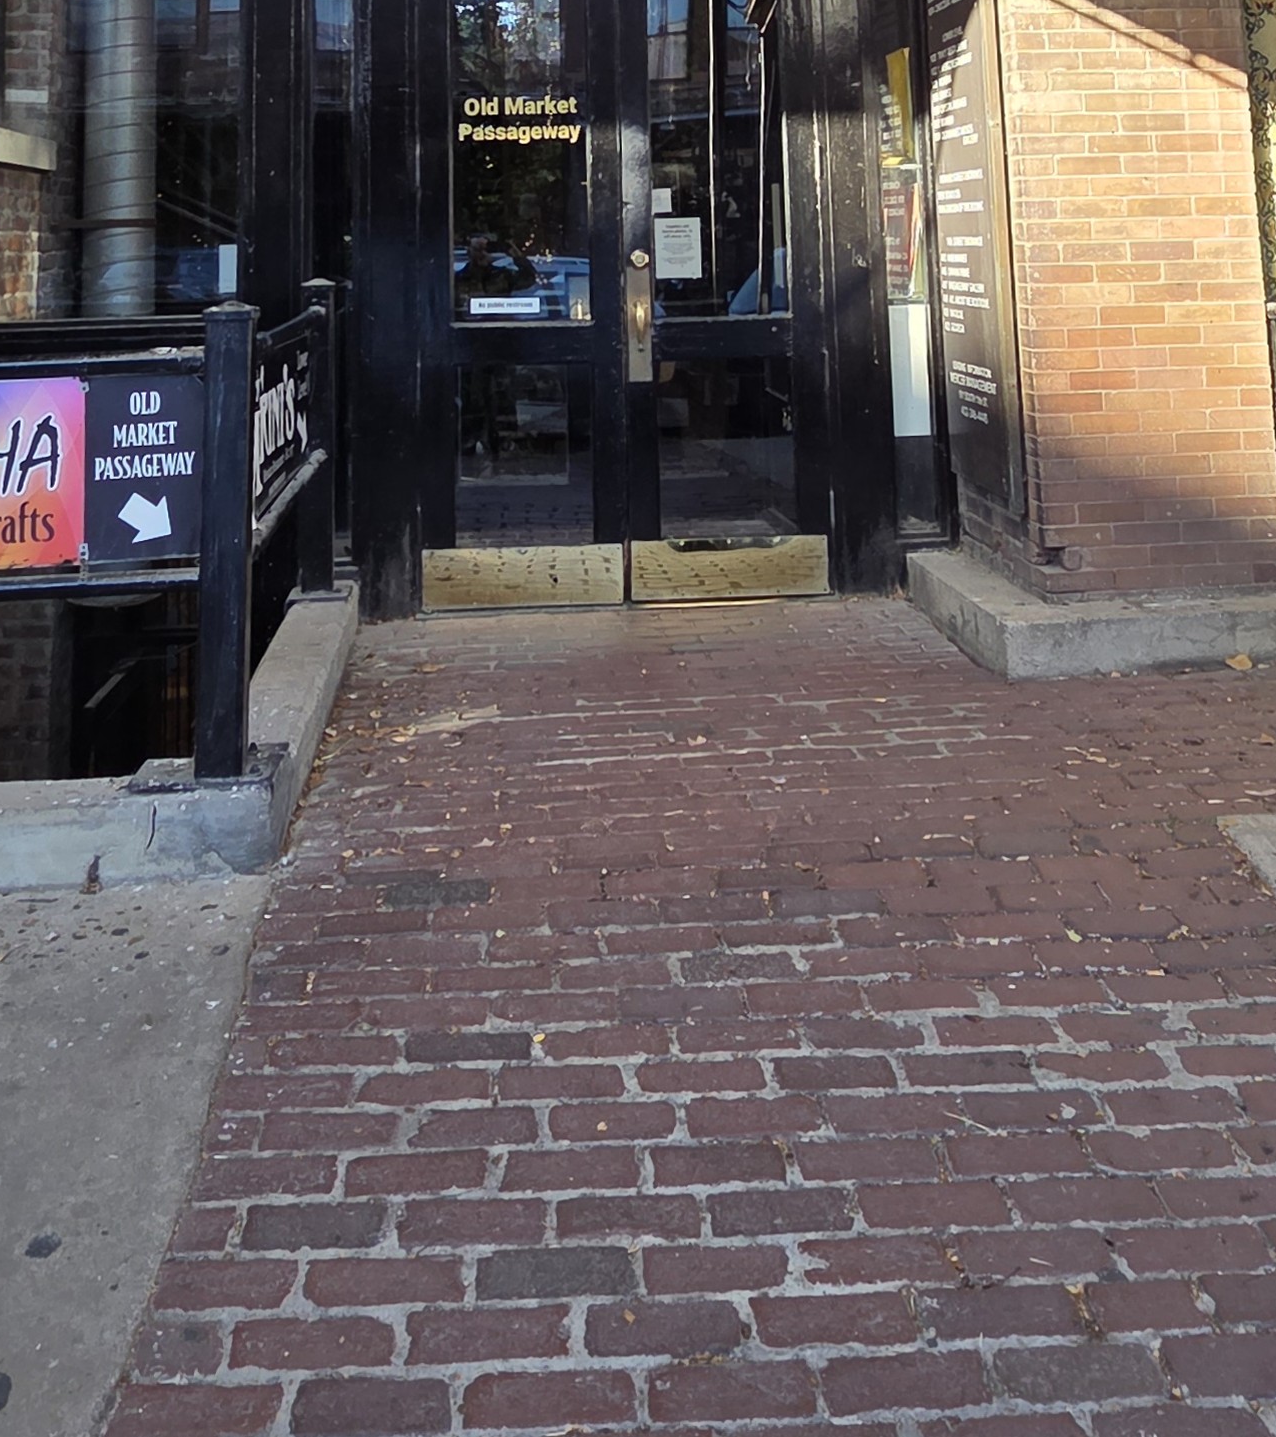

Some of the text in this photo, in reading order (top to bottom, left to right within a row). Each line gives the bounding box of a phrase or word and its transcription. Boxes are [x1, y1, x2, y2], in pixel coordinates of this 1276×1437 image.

[464, 96, 578, 116] Old Market
[458, 123, 582, 144] Passageway
[129, 390, 162, 417] OLD
[112, 421, 178, 449] MARKET
[94, 450, 196, 482] PASSAGEWAY
